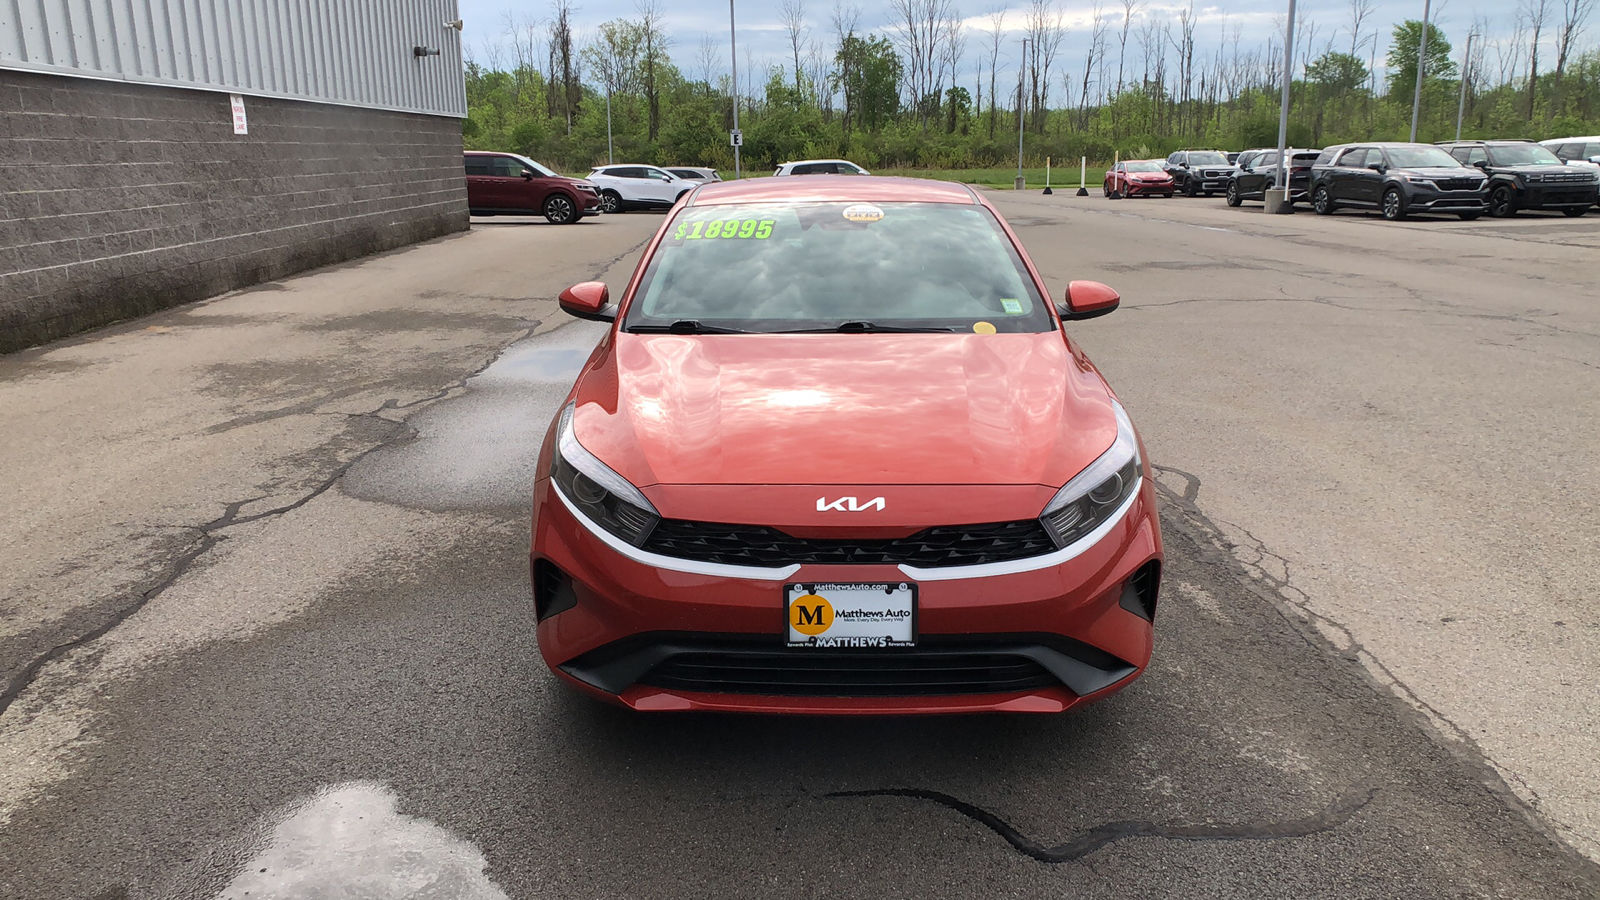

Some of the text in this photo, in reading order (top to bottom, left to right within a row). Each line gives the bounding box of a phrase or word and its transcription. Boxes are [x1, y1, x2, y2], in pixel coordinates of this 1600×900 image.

[734, 134, 739, 144] E
[674, 219, 775, 241] $18995
[816, 496, 886, 512] KIA
[796, 605, 825, 625] M
[835, 608, 911, 618] Matthews Auto
[815, 637, 887, 647] MATTHEWS
